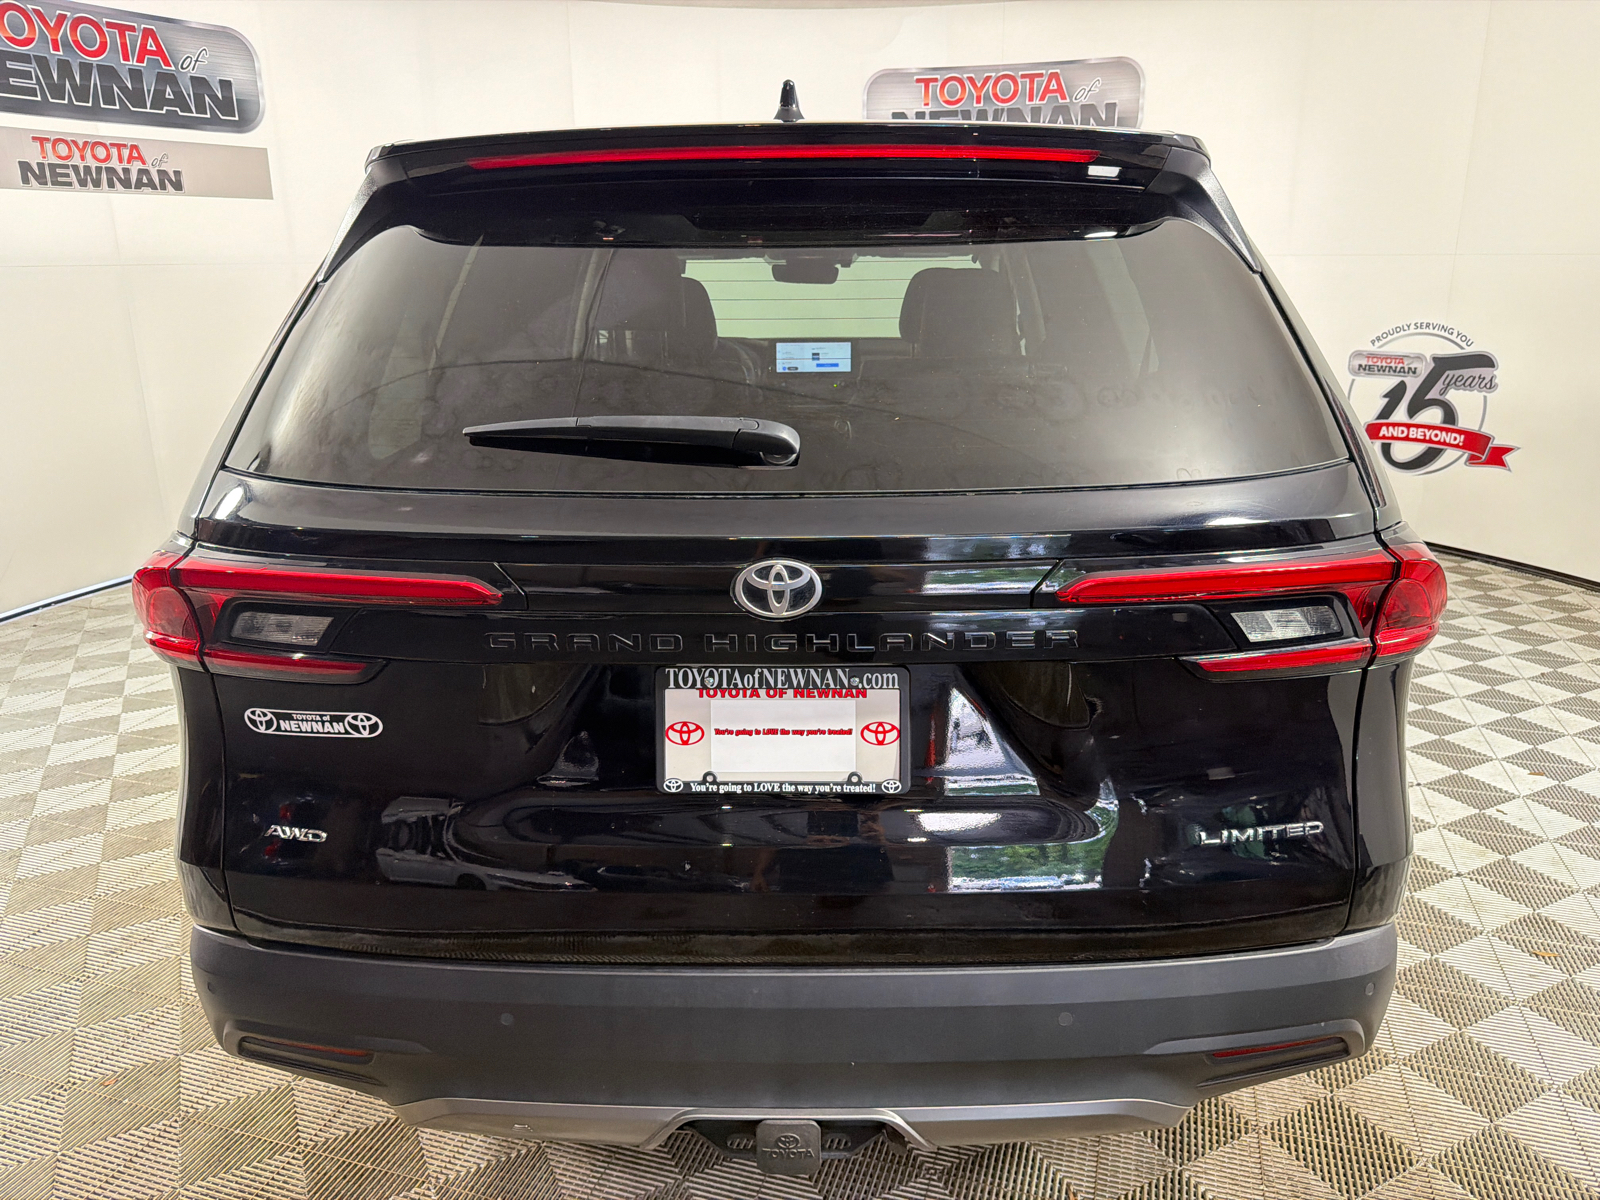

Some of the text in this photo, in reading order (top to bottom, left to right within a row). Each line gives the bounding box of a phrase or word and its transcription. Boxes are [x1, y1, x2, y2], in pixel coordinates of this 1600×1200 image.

[0, 1, 208, 72] OYOTA of
[0, 48, 239, 120] EWNAN
[914, 70, 1101, 108] TOYOTA of
[31, 135, 168, 168] TOYOTA of
[17, 160, 185, 192] NEWNAN
[1370, 322, 1475, 348] PROUDLY SERVING YOU
[1357, 363, 1418, 375] NEWNAN
[1365, 355, 1405, 366] TOYOTA
[1438, 373, 1496, 396] years
[1379, 426, 1465, 446] AND BEYOND!
[484, 629, 1080, 652] GRAND HIGHLANDER
[697, 688, 867, 698] TOYOTA OF NEWNAN
[279, 719, 345, 733] NEWNAN
[690, 783, 876, 794] You're going to LOVE the way you're treated!
[264, 824, 328, 843] AWD
[1199, 821, 1324, 845] LIMITED
[761, 1147, 815, 1159] TOYOTA
